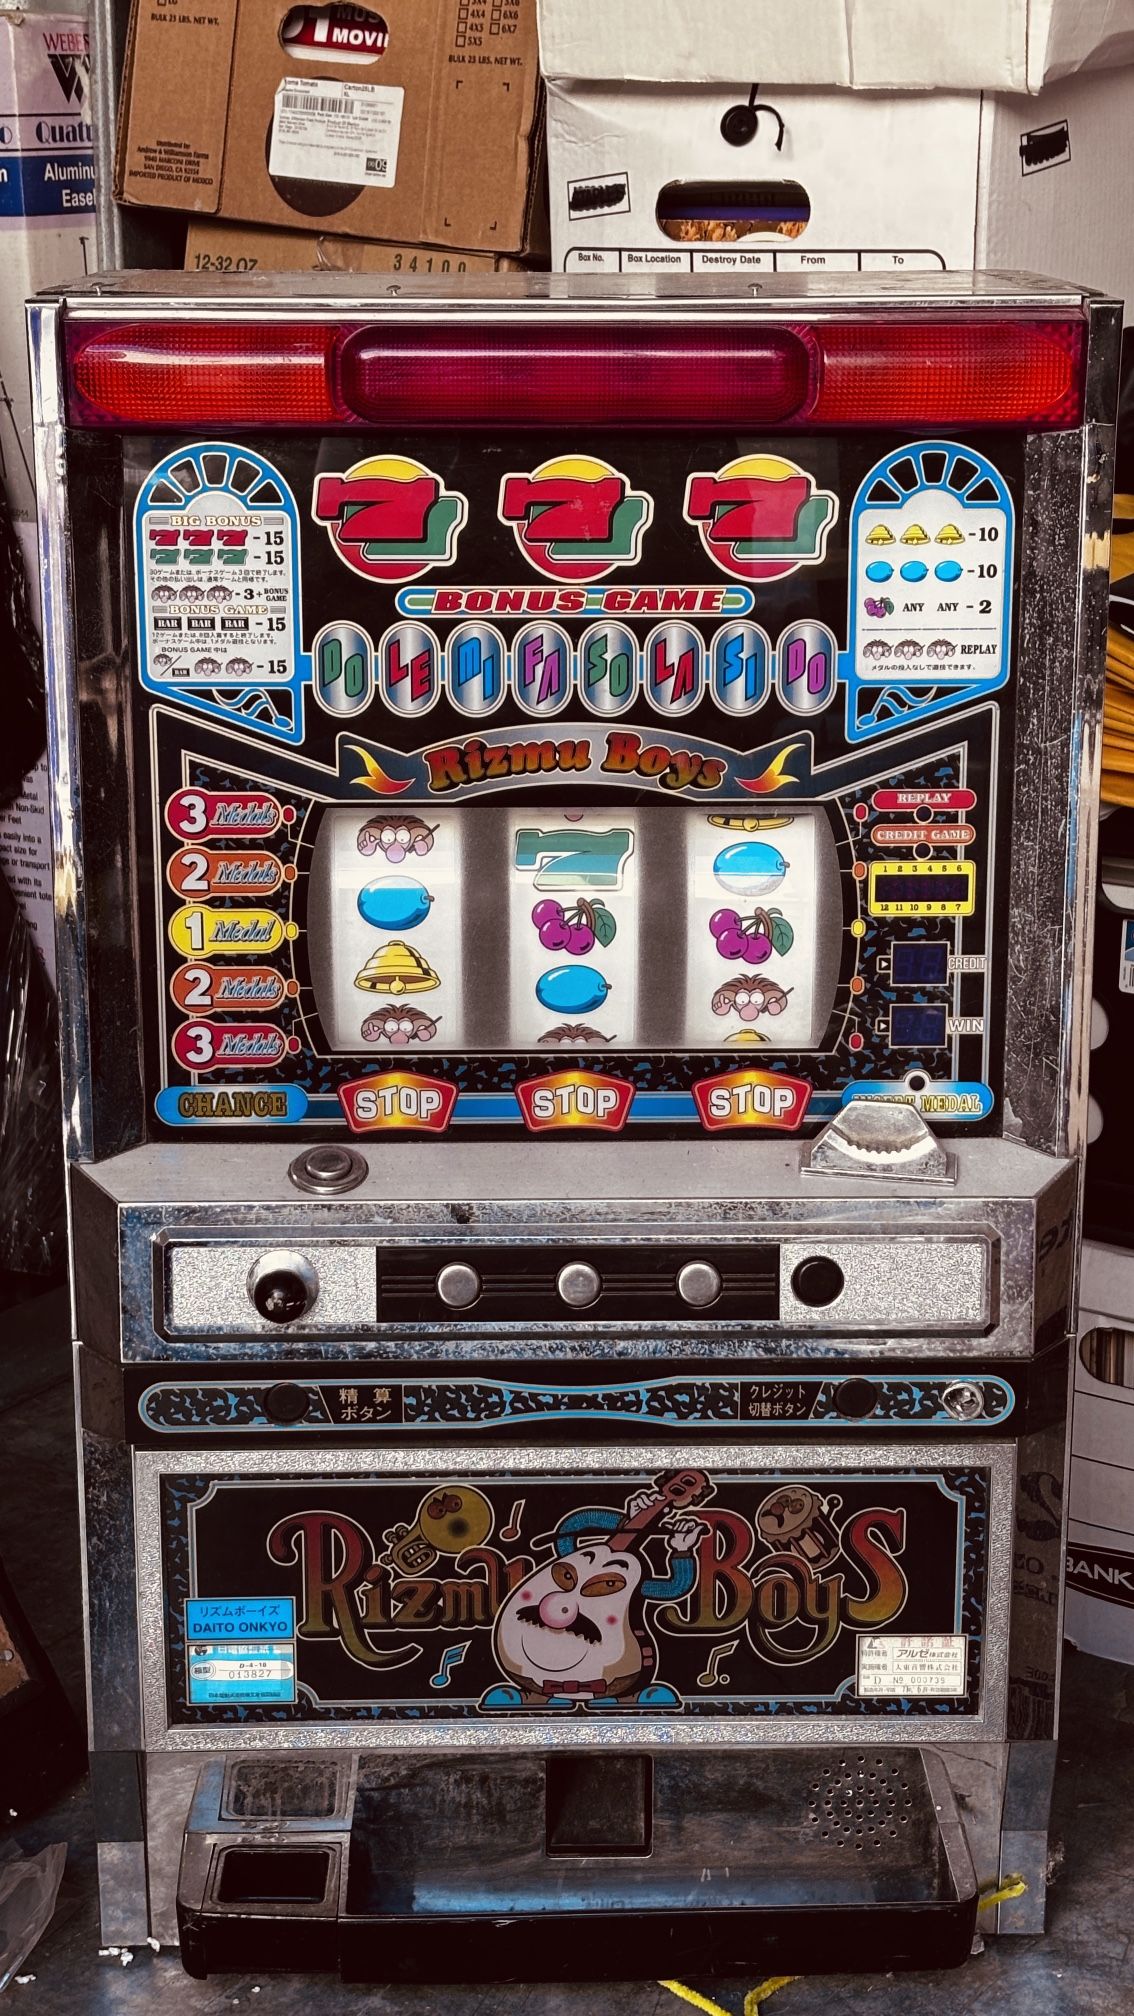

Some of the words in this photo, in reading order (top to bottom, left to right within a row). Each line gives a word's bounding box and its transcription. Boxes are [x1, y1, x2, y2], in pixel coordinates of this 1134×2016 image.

[194, 16, 206, 25] NET
[503, 10, 519, 20] 6X6
[502, 24, 517, 34] 6X7
[494, 57, 508, 65] NET
[129, 169, 157, 180] IMPORTED
[157, 171, 183, 182] PRODUCT
[184, 175, 191, 183] OF
[192, 177, 213, 186] MEXICO
[195, 253, 232, 271] 12-32
[578, 253, 591, 262] Box
[592, 253, 605, 262] No.
[628, 254, 643, 264] Box
[645, 254, 681, 264] Location
[702, 255, 737, 266] Destroy
[739, 255, 761, 265] Date
[800, 255, 826, 265] From
[893, 256, 905, 265] To
[170, 515, 201, 527] BIG
[205, 515, 262, 527] BONUS
[431, 587, 586, 614] BONUS
[599, 587, 727, 614] GAME
[168, 604, 220, 616] BONUS
[223, 604, 269, 616] GAME
[903, 602, 925, 613] ANY
[937, 602, 959, 613] ANY
[158, 619, 178, 628] BAR
[191, 619, 211, 628] BAR
[225, 619, 245, 628] BAR
[961, 644, 998, 655] REPLAY
[322, 638, 365, 698] DO
[389, 634, 431, 702] LE
[458, 636, 495, 701] MI
[524, 633, 561, 706] FA
[587, 633, 628, 698] SO
[655, 633, 695, 704] LA
[722, 632, 758, 701] SI
[786, 634, 827, 696] DO
[423, 734, 592, 792] Rizmu
[603, 731, 727, 792] Boys
[896, 792, 952, 804] REPLAY
[179, 795, 207, 832] 3
[210, 802, 278, 827] Medals
[877, 830, 928, 841] CREDIT
[931, 830, 971, 841] GAME
[180, 854, 209, 891] 2
[213, 861, 278, 885] Medals
[184, 911, 204, 949] 1
[208, 920, 275, 943] Medal
[948, 957, 987, 970] CREDIT
[184, 969, 212, 1005] 2
[216, 976, 281, 999] Medals
[948, 1018, 985, 1032] WIN
[185, 1026, 212, 1064] 3
[217, 1033, 282, 1057] Medals
[178, 1091, 287, 1118] CHANCE
[354, 1084, 442, 1119] STOP
[532, 1084, 619, 1119] STOP
[708, 1084, 796, 1119] STOP
[920, 1094, 981, 1114] MEDAL
[749, 1384, 806, 1400] クレジット
[341, 1406, 393, 1421] ボタン
[749, 1401, 807, 1418] 切替ボタン
[200, 1605, 280, 1617] リズムボーイズ
[193, 1622, 235, 1633] DAITO
[239, 1621, 288, 1633] ONKYO
[228, 1669, 272, 1680] 013827
